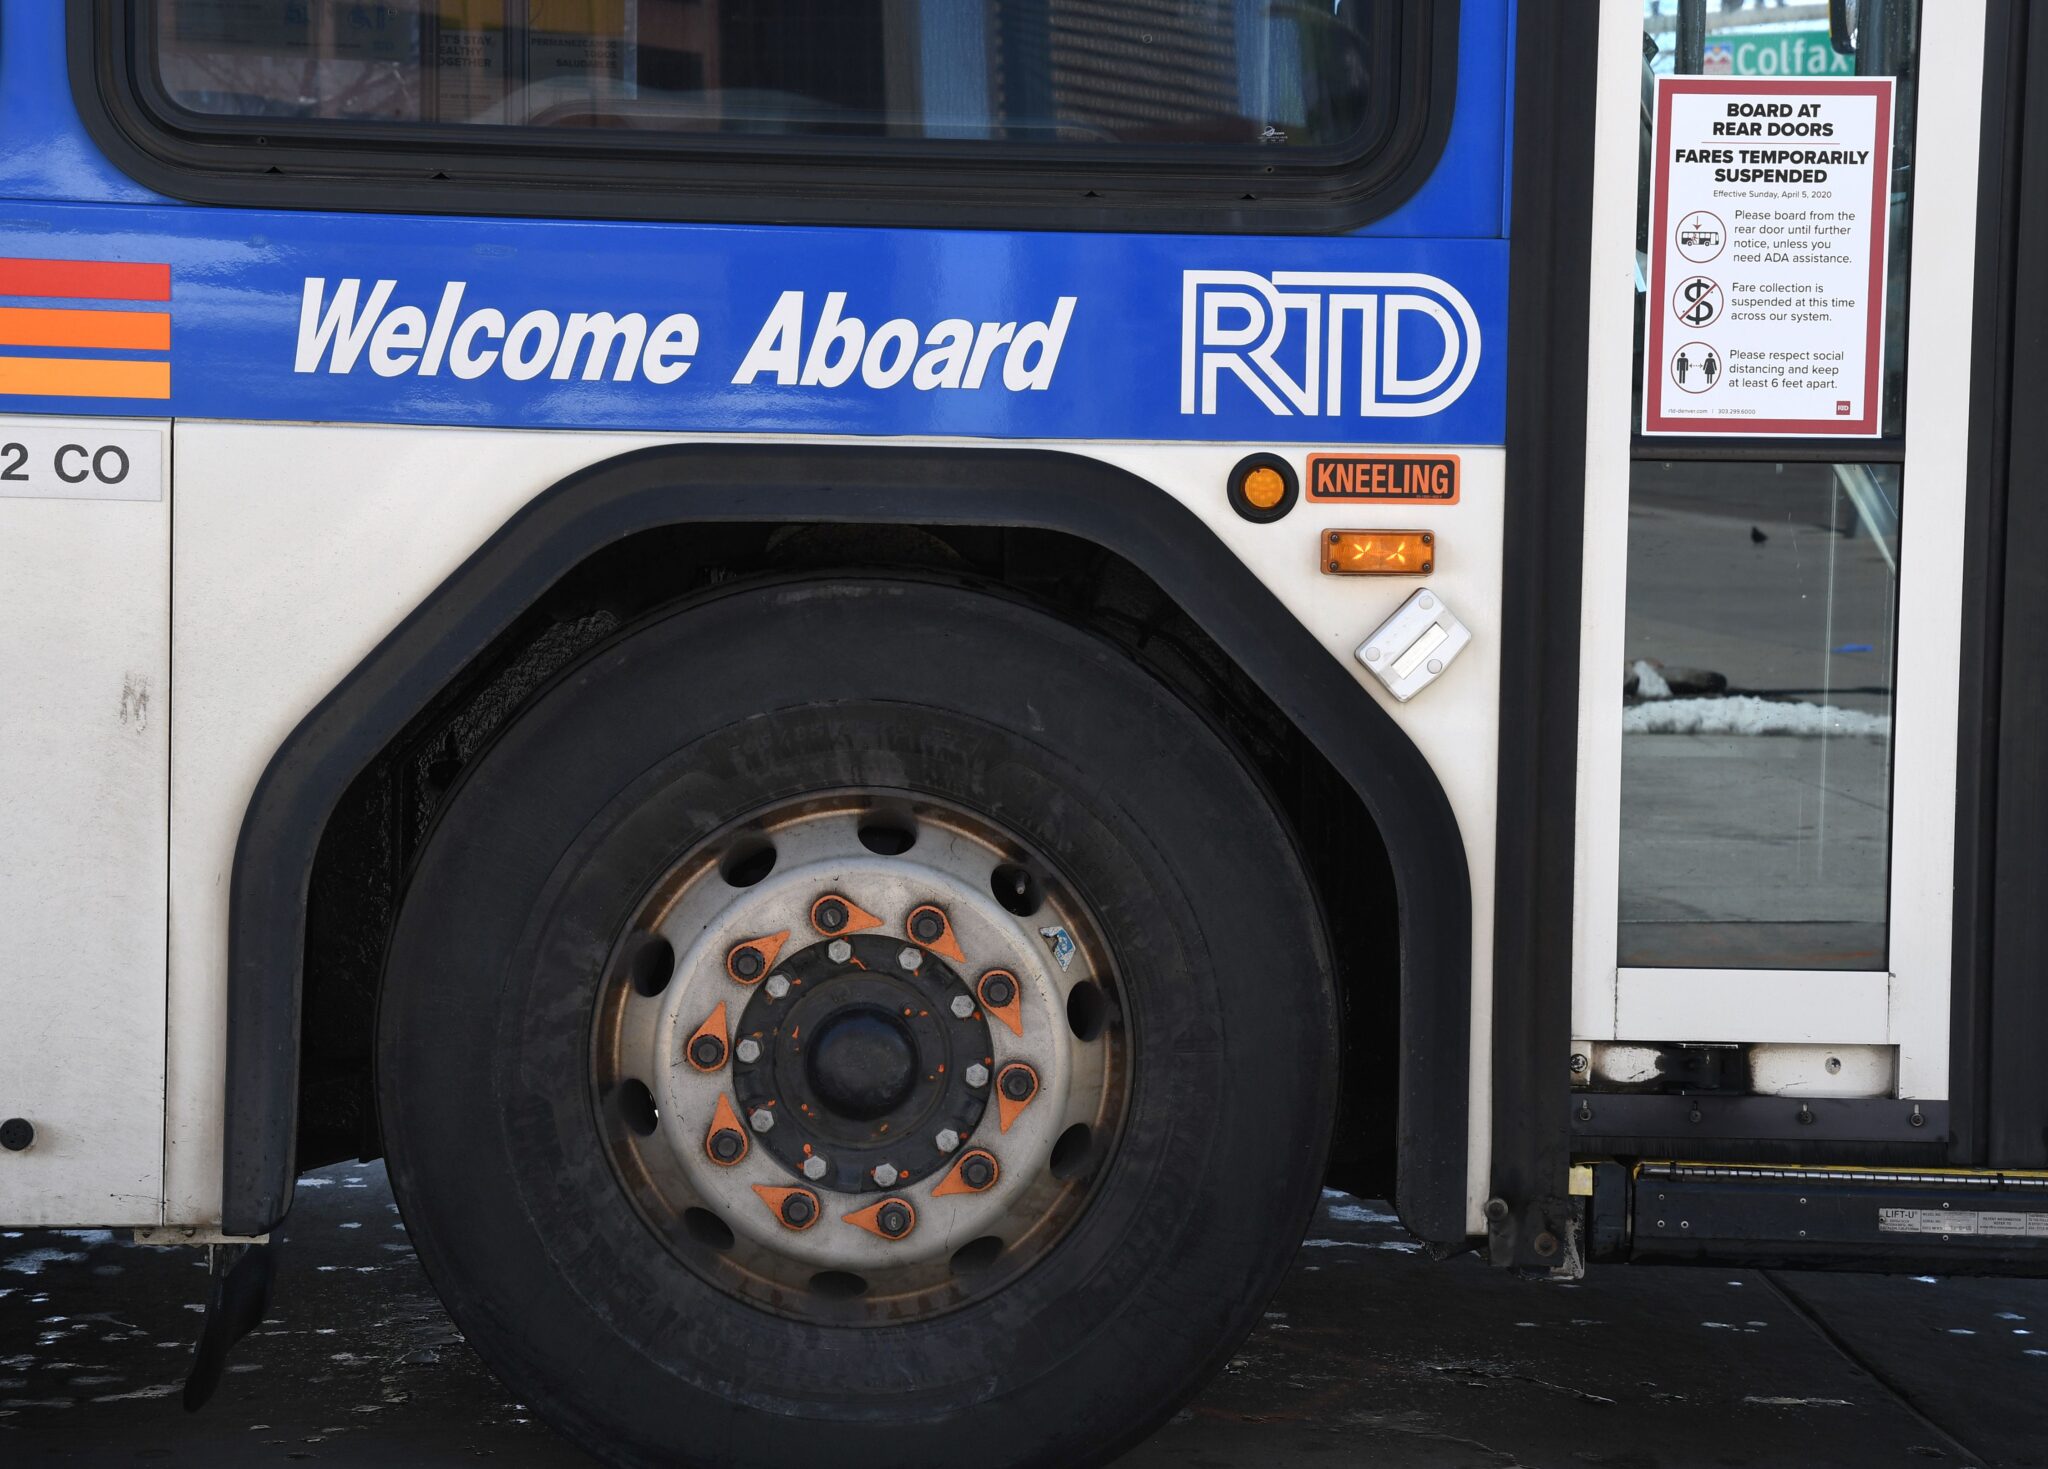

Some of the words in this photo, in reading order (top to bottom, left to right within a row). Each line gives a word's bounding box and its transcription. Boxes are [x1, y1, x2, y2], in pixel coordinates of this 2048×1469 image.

[439, 46, 482, 56] EALTHY
[1736, 38, 1850, 75] Colfax
[439, 57, 492, 67] OGETHER
[1727, 103, 1793, 118] BOARD
[1797, 103, 1821, 118] AT
[1712, 122, 1762, 136] REAR
[1767, 122, 1834, 137] DOORS
[1675, 149, 1734, 164] FARES
[1739, 150, 1870, 165] TEMPORARILY
[1714, 168, 1828, 184] SUSPENDED
[1713, 190, 1747, 198] Effective
[1749, 190, 1780, 199] Sunday,
[1781, 190, 1800, 199] April
[1801, 191, 1809, 199] 5,
[1735, 210, 1771, 220] Please
[1774, 210, 1806, 220] board
[1809, 211, 1834, 221] from
[1838, 211, 1856, 221] the
[1734, 225, 1756, 234] rear
[1759, 224, 1785, 235] door
[1788, 225, 1811, 235] until
[1814, 225, 1851, 235] further
[1733, 239, 1770, 250] notice,
[1773, 239, 1808, 249] unless
[1811, 240, 1831, 251] you
[1733, 253, 1761, 263] need
[1764, 253, 1790, 263] ADA
[1792, 253, 1852, 264] assistance.
[1732, 282, 1756, 293] Fare
[1759, 283, 1812, 293] collection
[1815, 283, 1824, 293] is
[1731, 297, 1792, 308] suspended
[1795, 298, 1806, 307] at
[1809, 297, 1828, 307] this
[1831, 298, 1856, 308] time
[1731, 312, 1766, 321] across
[1769, 313, 1787, 321] our
[1790, 312, 1832, 324] system.
[294, 277, 700, 385] Welcome
[732, 290, 1077, 391] Aboard
[1181, 269, 1482, 417] RTD
[1729, 349, 1766, 360] Please
[1769, 350, 1810, 362] respect
[1812, 350, 1845, 361] social
[1729, 363, 1785, 376] distancing
[1788, 364, 1809, 375] and
[1812, 364, 1839, 377] keep
[1728, 379, 1739, 388] at
[1742, 378, 1768, 388] least
[1771, 378, 1779, 388] 6
[1781, 378, 1803, 389] feet
[1806, 379, 1838, 390] apart.
[0, 442, 30, 481] 2
[53, 443, 130, 485] CO
[1317, 463, 1449, 495] KNEELING
